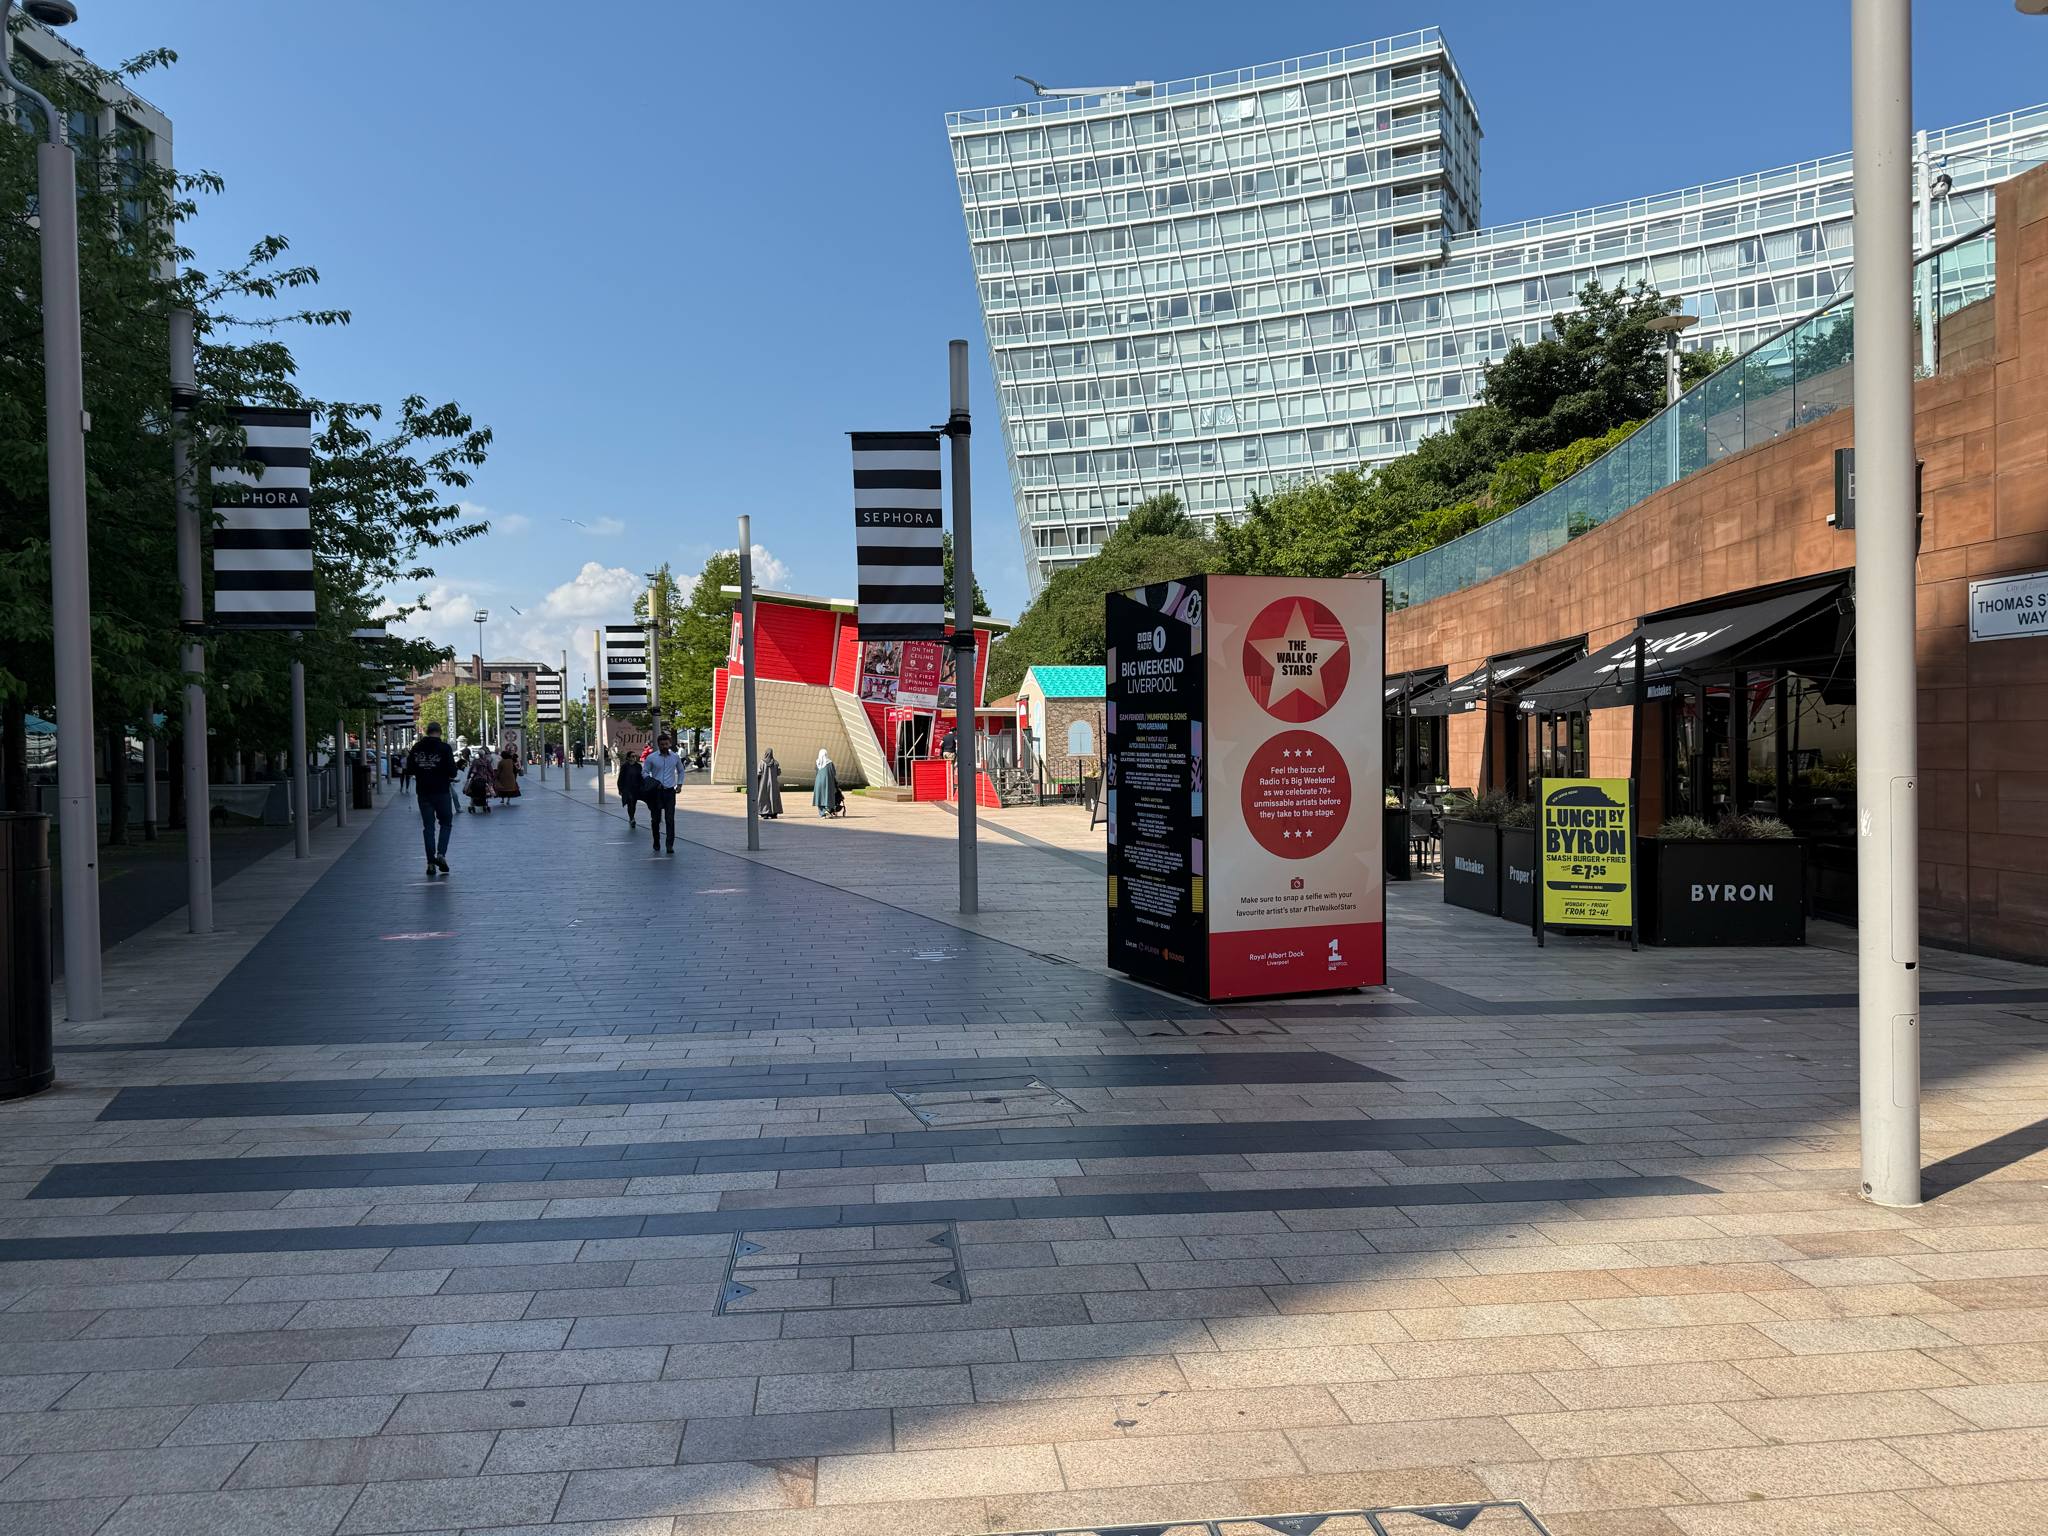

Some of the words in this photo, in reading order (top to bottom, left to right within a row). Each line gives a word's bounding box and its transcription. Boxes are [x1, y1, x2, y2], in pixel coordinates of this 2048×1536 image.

[223, 492, 299, 504] PHORA
[863, 512, 934, 524] SEPHORA
[1977, 595, 2034, 613] THOMAS
[2037, 593, 2048, 606] S
[2017, 610, 2048, 625] WAY
[1137, 631, 1152, 642] BBC
[1137, 642, 1152, 651] RADIO
[1288, 640, 1307, 651] THE
[1277, 652, 1304, 664] WALK
[1305, 652, 1318, 664] OF
[1121, 661, 1137, 677] BIG
[1138, 657, 1184, 676] WEEKEND
[1281, 664, 1313, 676] STARS
[904, 679, 933, 687] SPINNING
[1127, 676, 1178, 694] LIVERPOOL
[1147, 713, 1170, 721] MUMFORD
[1174, 712, 1188, 721] SONS
[1271, 766, 1286, 774] Feel
[1287, 766, 1299, 774] the
[1300, 765, 1316, 773] buzz
[1317, 765, 1325, 773] of
[1260, 777, 1280, 786] Radio
[1291, 777, 1303, 787] Big
[1304, 775, 1336, 784] Weekend
[1263, 789, 1272, 797] as
[1285, 787, 1318, 796] celebrate
[1319, 787, 1331, 795] 70+
[1253, 798, 1295, 808] unmissable
[1295, 798, 1318, 807] artists
[1319, 797, 1341, 806] before
[1259, 809, 1275, 819] they
[1277, 809, 1292, 818] take
[1293, 809, 1301, 817] to
[1302, 808, 1313, 817] the
[1314, 808, 1336, 818] stage.
[1546, 808, 1607, 828] LUNCH
[1609, 809, 1625, 823] BY
[1546, 828, 1626, 855] BYRON
[1454, 855, 1485, 875] Milkshakes
[1546, 854, 1572, 862] SMASH
[1573, 855, 1601, 863] BURGER
[1606, 856, 1627, 864] FRIES
[1509, 865, 1530, 885] Proper
[1571, 864, 1607, 880] £7.95
[1240, 896, 1259, 904] Make
[1283, 894, 1299, 904] snap
[1305, 892, 1323, 900] selfie
[1323, 891, 1338, 899] with
[1338, 891, 1353, 900] your
[1690, 884, 1774, 902] BYRON
[1236, 908, 1265, 917] favourite
[1266, 906, 1289, 915] artist's
[1289, 906, 1302, 914] star
[1564, 907, 1586, 916] FROM
[1588, 908, 1609, 917] 12-4!
[1249, 952, 1267, 962] Royal
[1267, 951, 1288, 960] Albert
[1288, 949, 1305, 958] Dock
[1266, 959, 1290, 967] Liverpool
